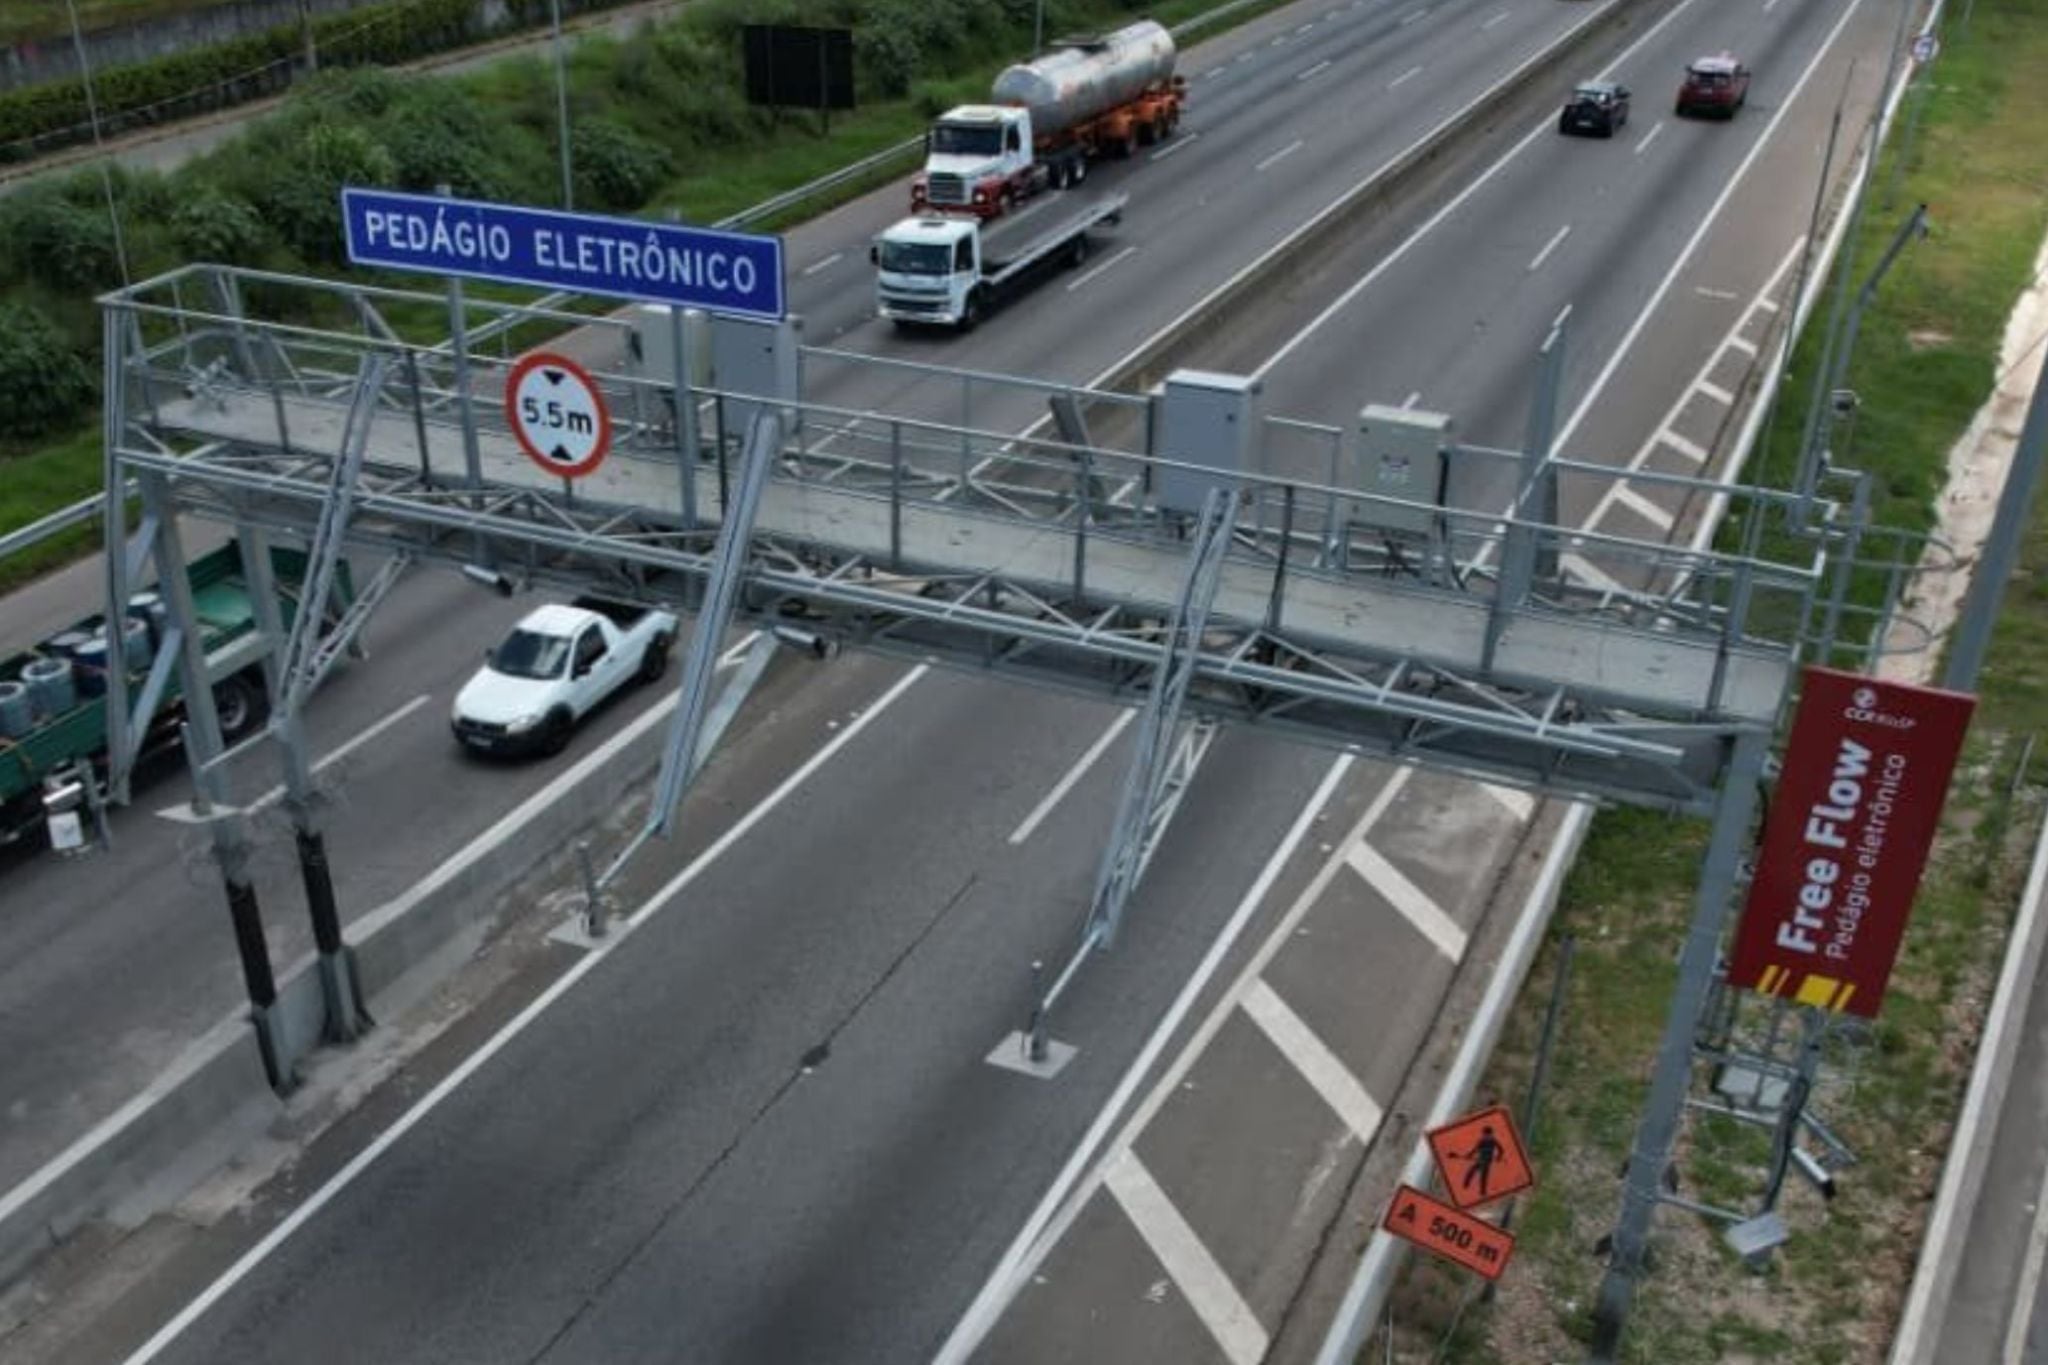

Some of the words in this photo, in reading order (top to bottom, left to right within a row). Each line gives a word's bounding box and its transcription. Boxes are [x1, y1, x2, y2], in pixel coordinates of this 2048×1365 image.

[365, 205, 511, 261] PEDÁGIO
[533, 230, 757, 293] ELETRÔNICO
[1804, 738, 1873, 849] Flow
[1825, 872, 1872, 960] Pedágio
[1857, 753, 1907, 868] eletrônico
[1776, 857, 1840, 954] Free
[1397, 1202, 1417, 1223] A
[1428, 1215, 1474, 1249] 500
[1475, 1241, 1499, 1263] m
